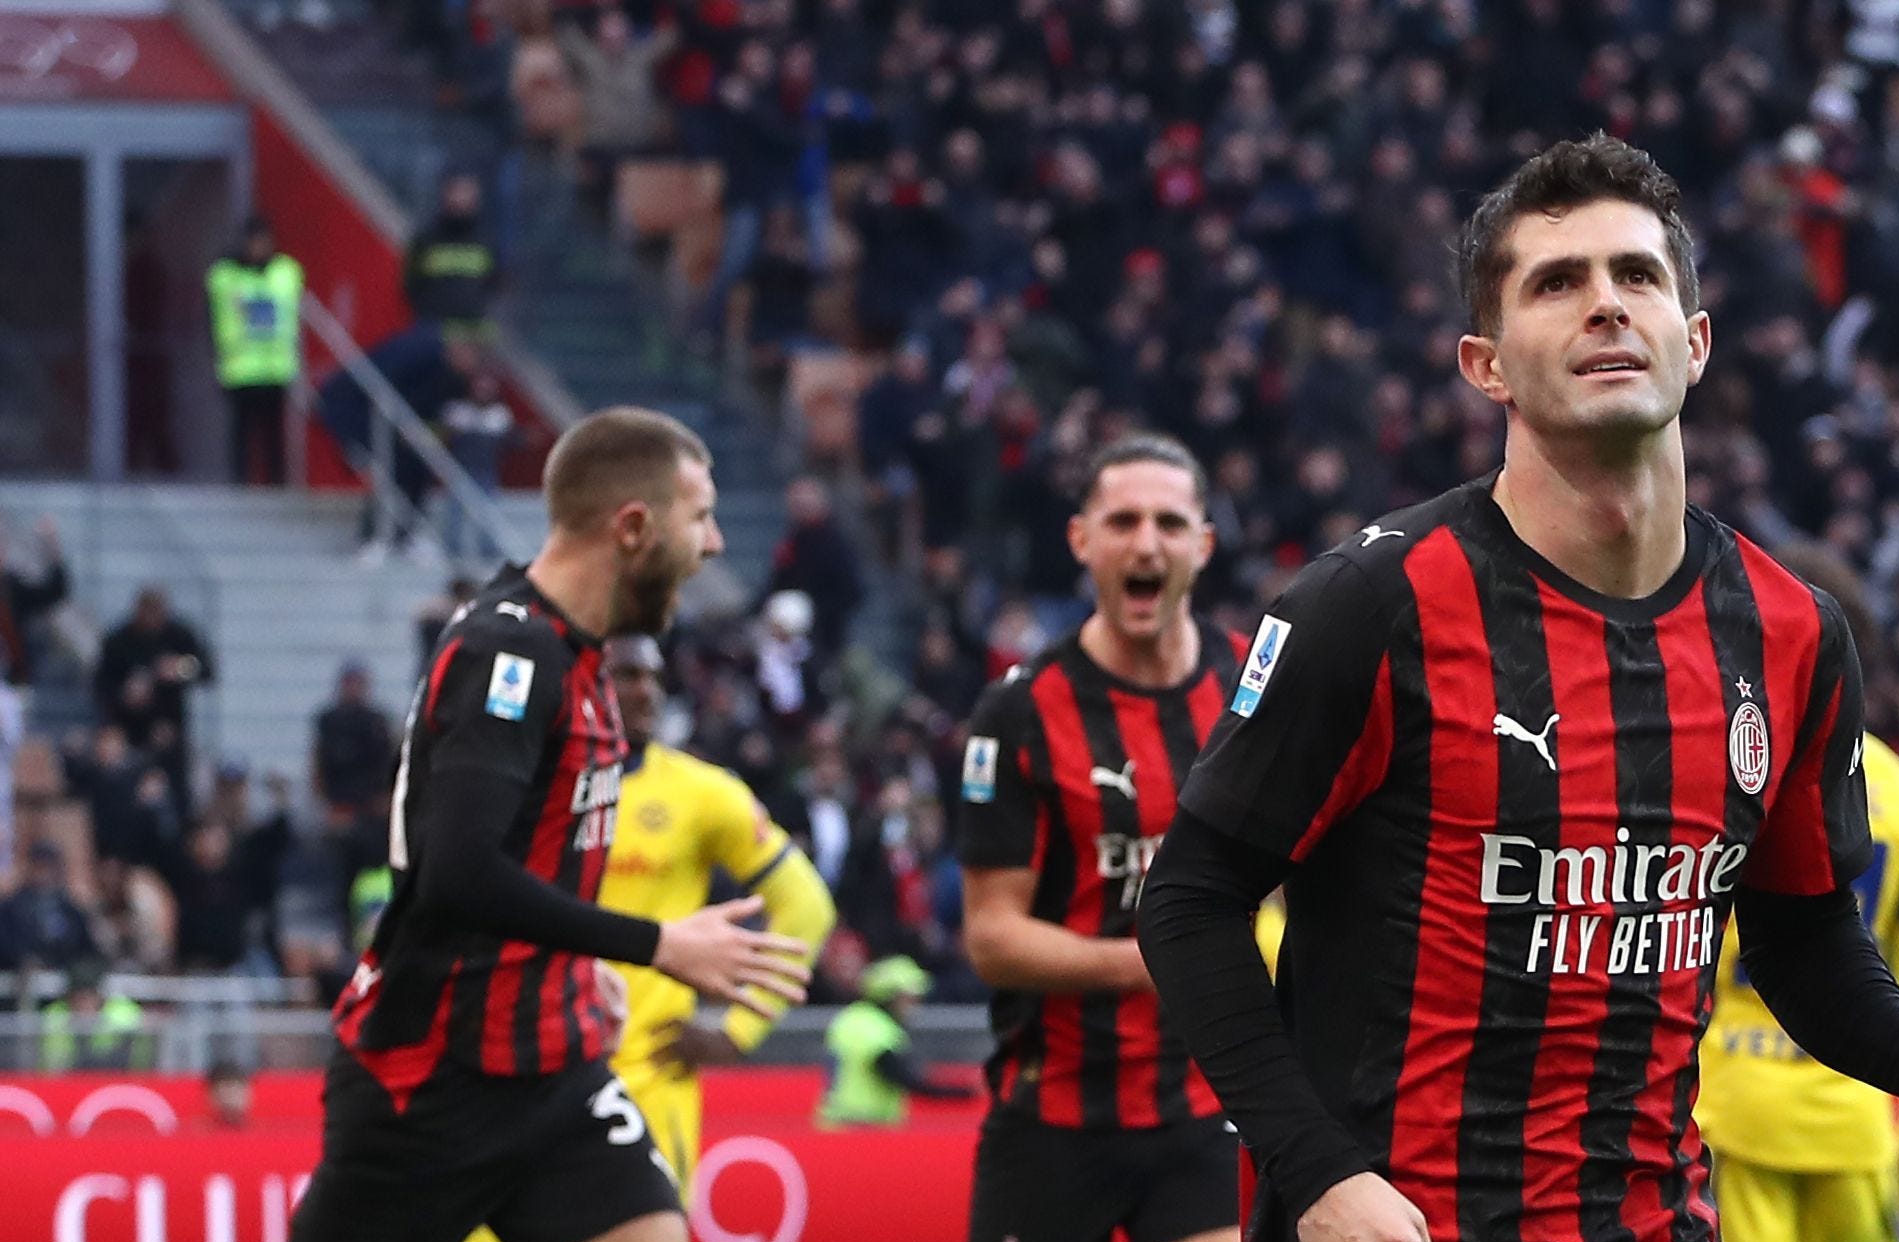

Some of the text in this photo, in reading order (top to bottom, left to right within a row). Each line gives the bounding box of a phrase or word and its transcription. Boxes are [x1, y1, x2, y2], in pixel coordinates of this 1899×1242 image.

[1480, 827, 1747, 906] Emirate
[1526, 906, 1714, 975] FLY BETTER
